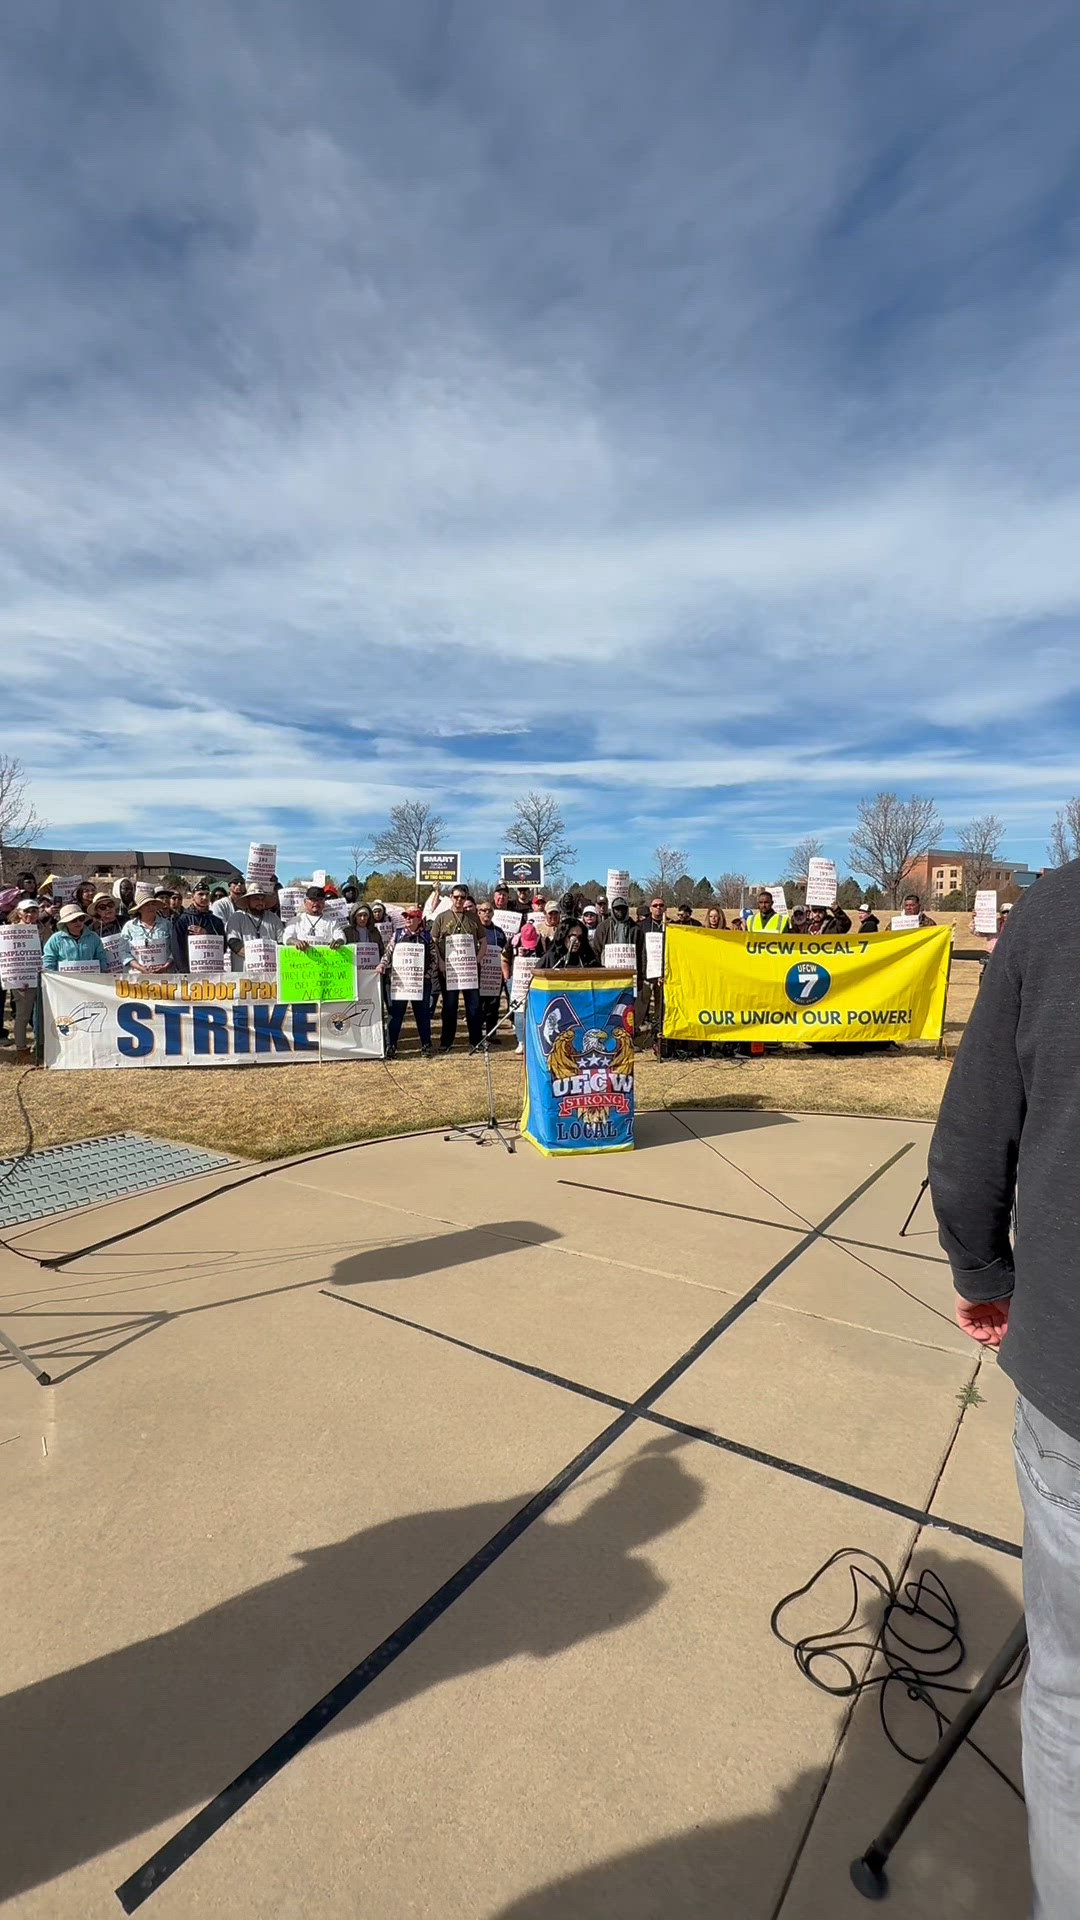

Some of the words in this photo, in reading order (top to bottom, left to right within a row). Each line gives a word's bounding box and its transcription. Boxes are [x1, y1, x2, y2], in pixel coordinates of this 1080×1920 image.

[13, 942, 26, 950] JBS
[746, 941, 795, 955] UFCW
[799, 941, 855, 955] LOCAL
[858, 941, 869, 954] 7
[797, 964, 817, 973] UFCW
[115, 978, 178, 1000] Unfair
[180, 978, 236, 1001] Labor
[239, 979, 278, 1001] Prac
[294, 981, 309, 990] GET
[798, 974, 819, 998] 7
[302, 988, 321, 1000] NO
[698, 1009, 735, 1025] OUR
[741, 1010, 797, 1025] UNION
[802, 1010, 842, 1025] OUR
[847, 1009, 912, 1025] POWER!
[116, 1002, 320, 1058] STRIKE
[552, 1071, 633, 1097] UFCW
[566, 1096, 621, 1106] STRONG
[556, 1120, 617, 1141] LOCAL
